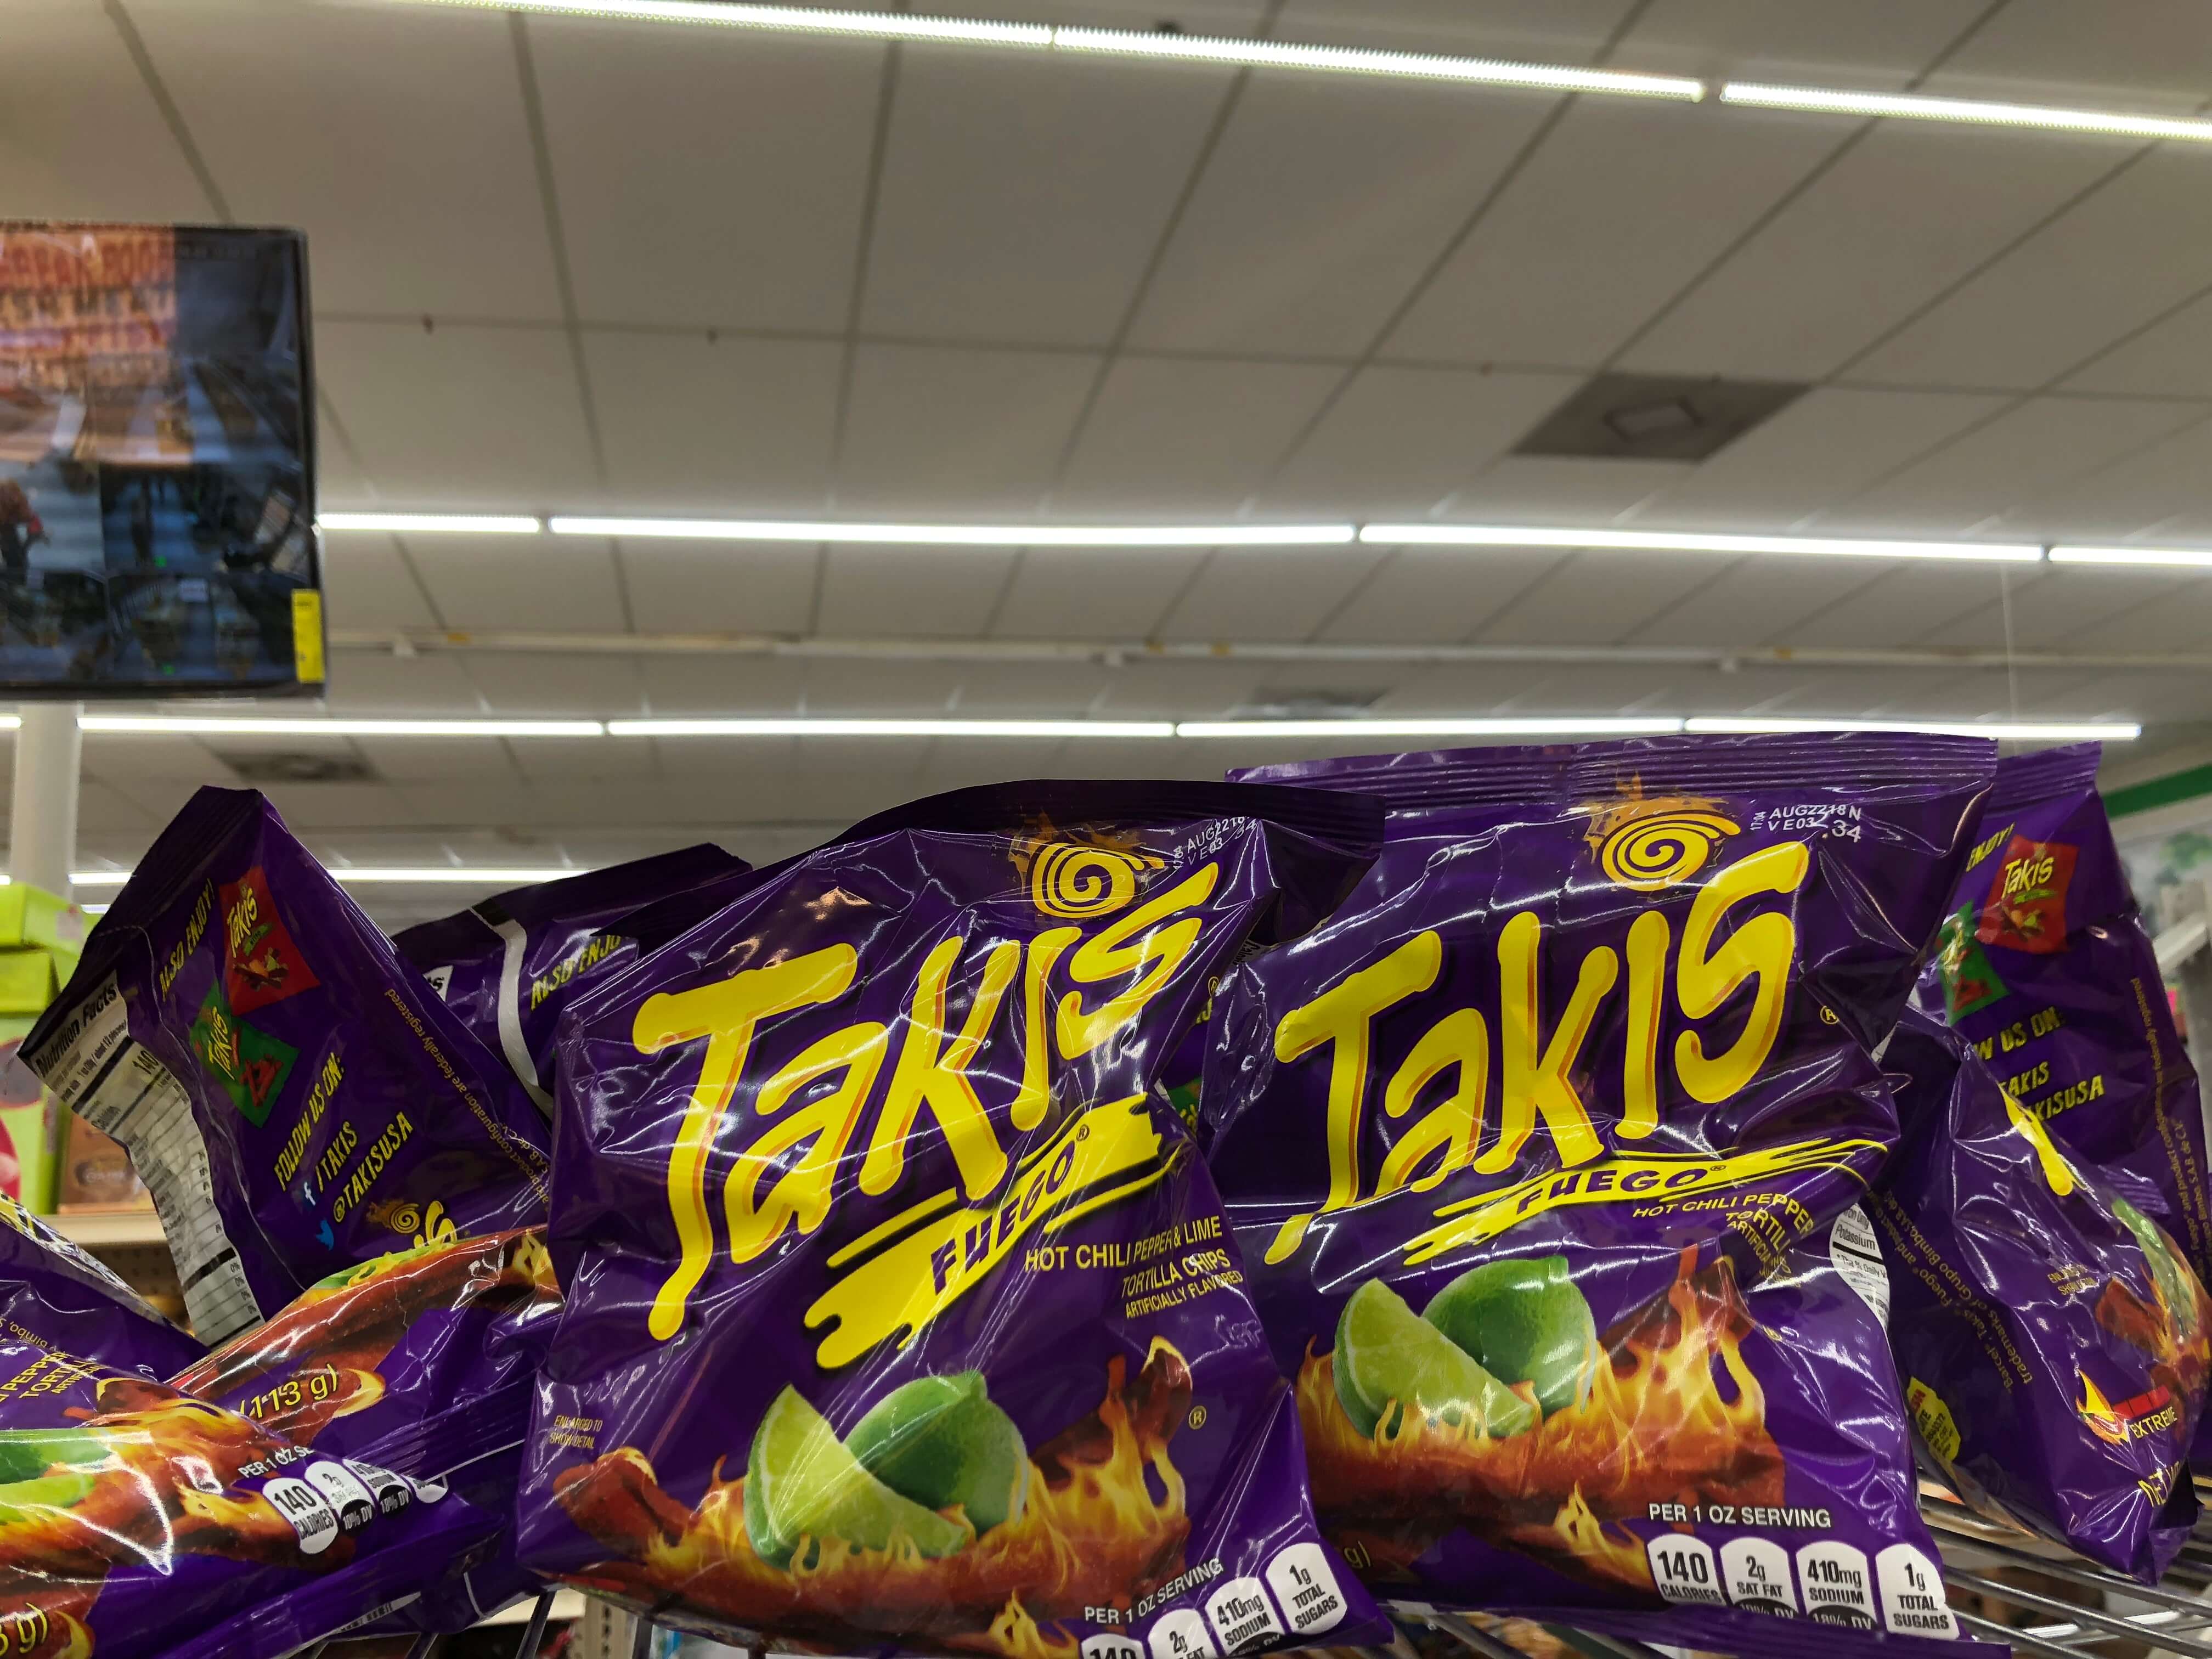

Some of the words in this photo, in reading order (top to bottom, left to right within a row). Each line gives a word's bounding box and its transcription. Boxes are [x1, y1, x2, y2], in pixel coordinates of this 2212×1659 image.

[385, 988, 426, 1037] registered
[35, 1018, 81, 1079] Nutrition
[82, 984, 117, 1028] Facts
[2000, 1021, 2028, 1053] US
[132, 1049, 160, 1075] 140
[421, 1036, 455, 1080] federally
[452, 1076, 467, 1093] are
[308, 1082, 326, 1124] US
[333, 1111, 414, 1223] @TAKISUSA
[1632, 1204, 1678, 1218] HOT
[1681, 1197, 1737, 1212] CHILI
[1742, 1193, 1815, 1234] PEPPER
[1024, 1246, 1069, 1273] HOT
[1075, 1243, 1131, 1269] CHILI
[1133, 1229, 1172, 1264] PEPPER
[1173, 1228, 1182, 1247] &
[1184, 1215, 1223, 1245] LIME
[1836, 1223, 1876, 1251] Potassium
[1897, 1243, 1917, 1265] and
[1121, 1261, 1183, 1299] TORTILLA
[1181, 1248, 1231, 1278] CHIPS
[1938, 1262, 1972, 1301] Grupo
[1125, 1286, 1186, 1319] ARTIFICIALLY
[1187, 1270, 1244, 1299] FLAVORED
[1988, 1310, 2033, 1385] trademarks
[311, 1363, 338, 1401] g)
[593, 1419, 603, 1432] TO
[237, 1460, 268, 1479] PER
[266, 1456, 274, 1470] 1
[274, 1447, 297, 1466] OZ
[274, 1485, 317, 1515] 140
[397, 1488, 410, 1507] DV
[293, 1508, 334, 1540] CALORIES
[342, 1509, 362, 1531] 10%
[360, 1504, 373, 1523] DV
[1649, 1503, 1687, 1522] PER
[1692, 1505, 1701, 1522] 1
[1709, 1505, 1736, 1524] OZ
[1741, 1505, 1831, 1528] SERVING
[1289, 1565, 1312, 1588] 1g
[1657, 1550, 1709, 1584] 140
[1746, 1555, 1767, 1582] 2g
[1807, 1559, 1862, 1588] 410mg
[1904, 1562, 1926, 1592] 1g
[1084, 1606, 1120, 1625] PER
[1125, 1609, 1134, 1624] 1
[1138, 1596, 1156, 1618] OZ
[1156, 1558, 1224, 1605] SERVING
[1292, 1583, 1326, 1610] TOTAL
[1660, 1583, 1722, 1604] CALORIES
[1736, 1581, 1759, 1596] SAT
[1763, 1584, 1782, 1598] FAT
[1808, 1587, 1865, 1605] SODIUM
[1897, 1594, 1938, 1611] TOTAL
[1216, 1594, 1265, 1627] 410mg
[1294, 1595, 1339, 1630] SUGARS
[1893, 1612, 1949, 1630] SUGARS
[1169, 1630, 1188, 1654] 2g
[1224, 1612, 1272, 1646] SODIUM
